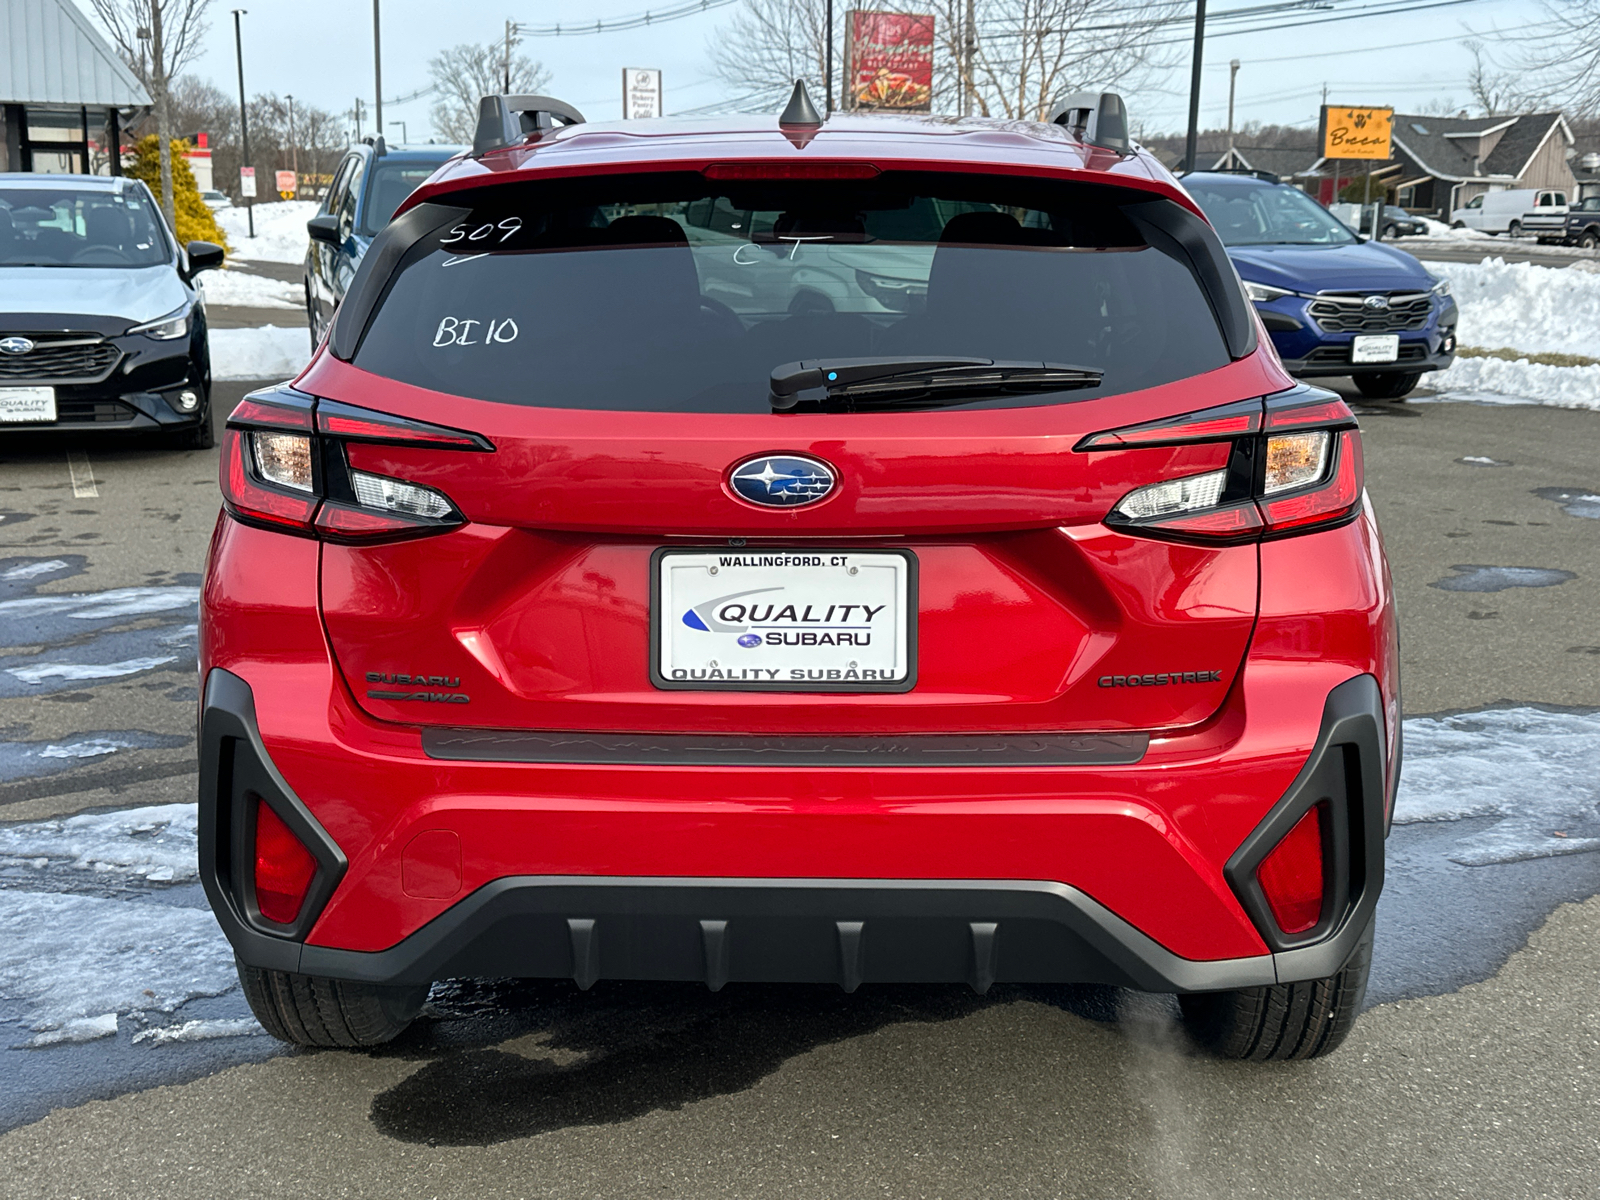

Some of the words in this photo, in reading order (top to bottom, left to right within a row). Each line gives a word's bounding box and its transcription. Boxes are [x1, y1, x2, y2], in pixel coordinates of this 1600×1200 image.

[719, 556, 826, 568] WALLINGFORD,
[830, 557, 848, 567] CT
[719, 604, 887, 623] QUALITY
[765, 632, 871, 646] SUBARU
[365, 672, 461, 687] SUBARU
[671, 668, 780, 680] QUALITY
[790, 668, 895, 680] SUBARU
[1098, 670, 1222, 687] CROSSTREK
[404, 692, 470, 704] AWD
